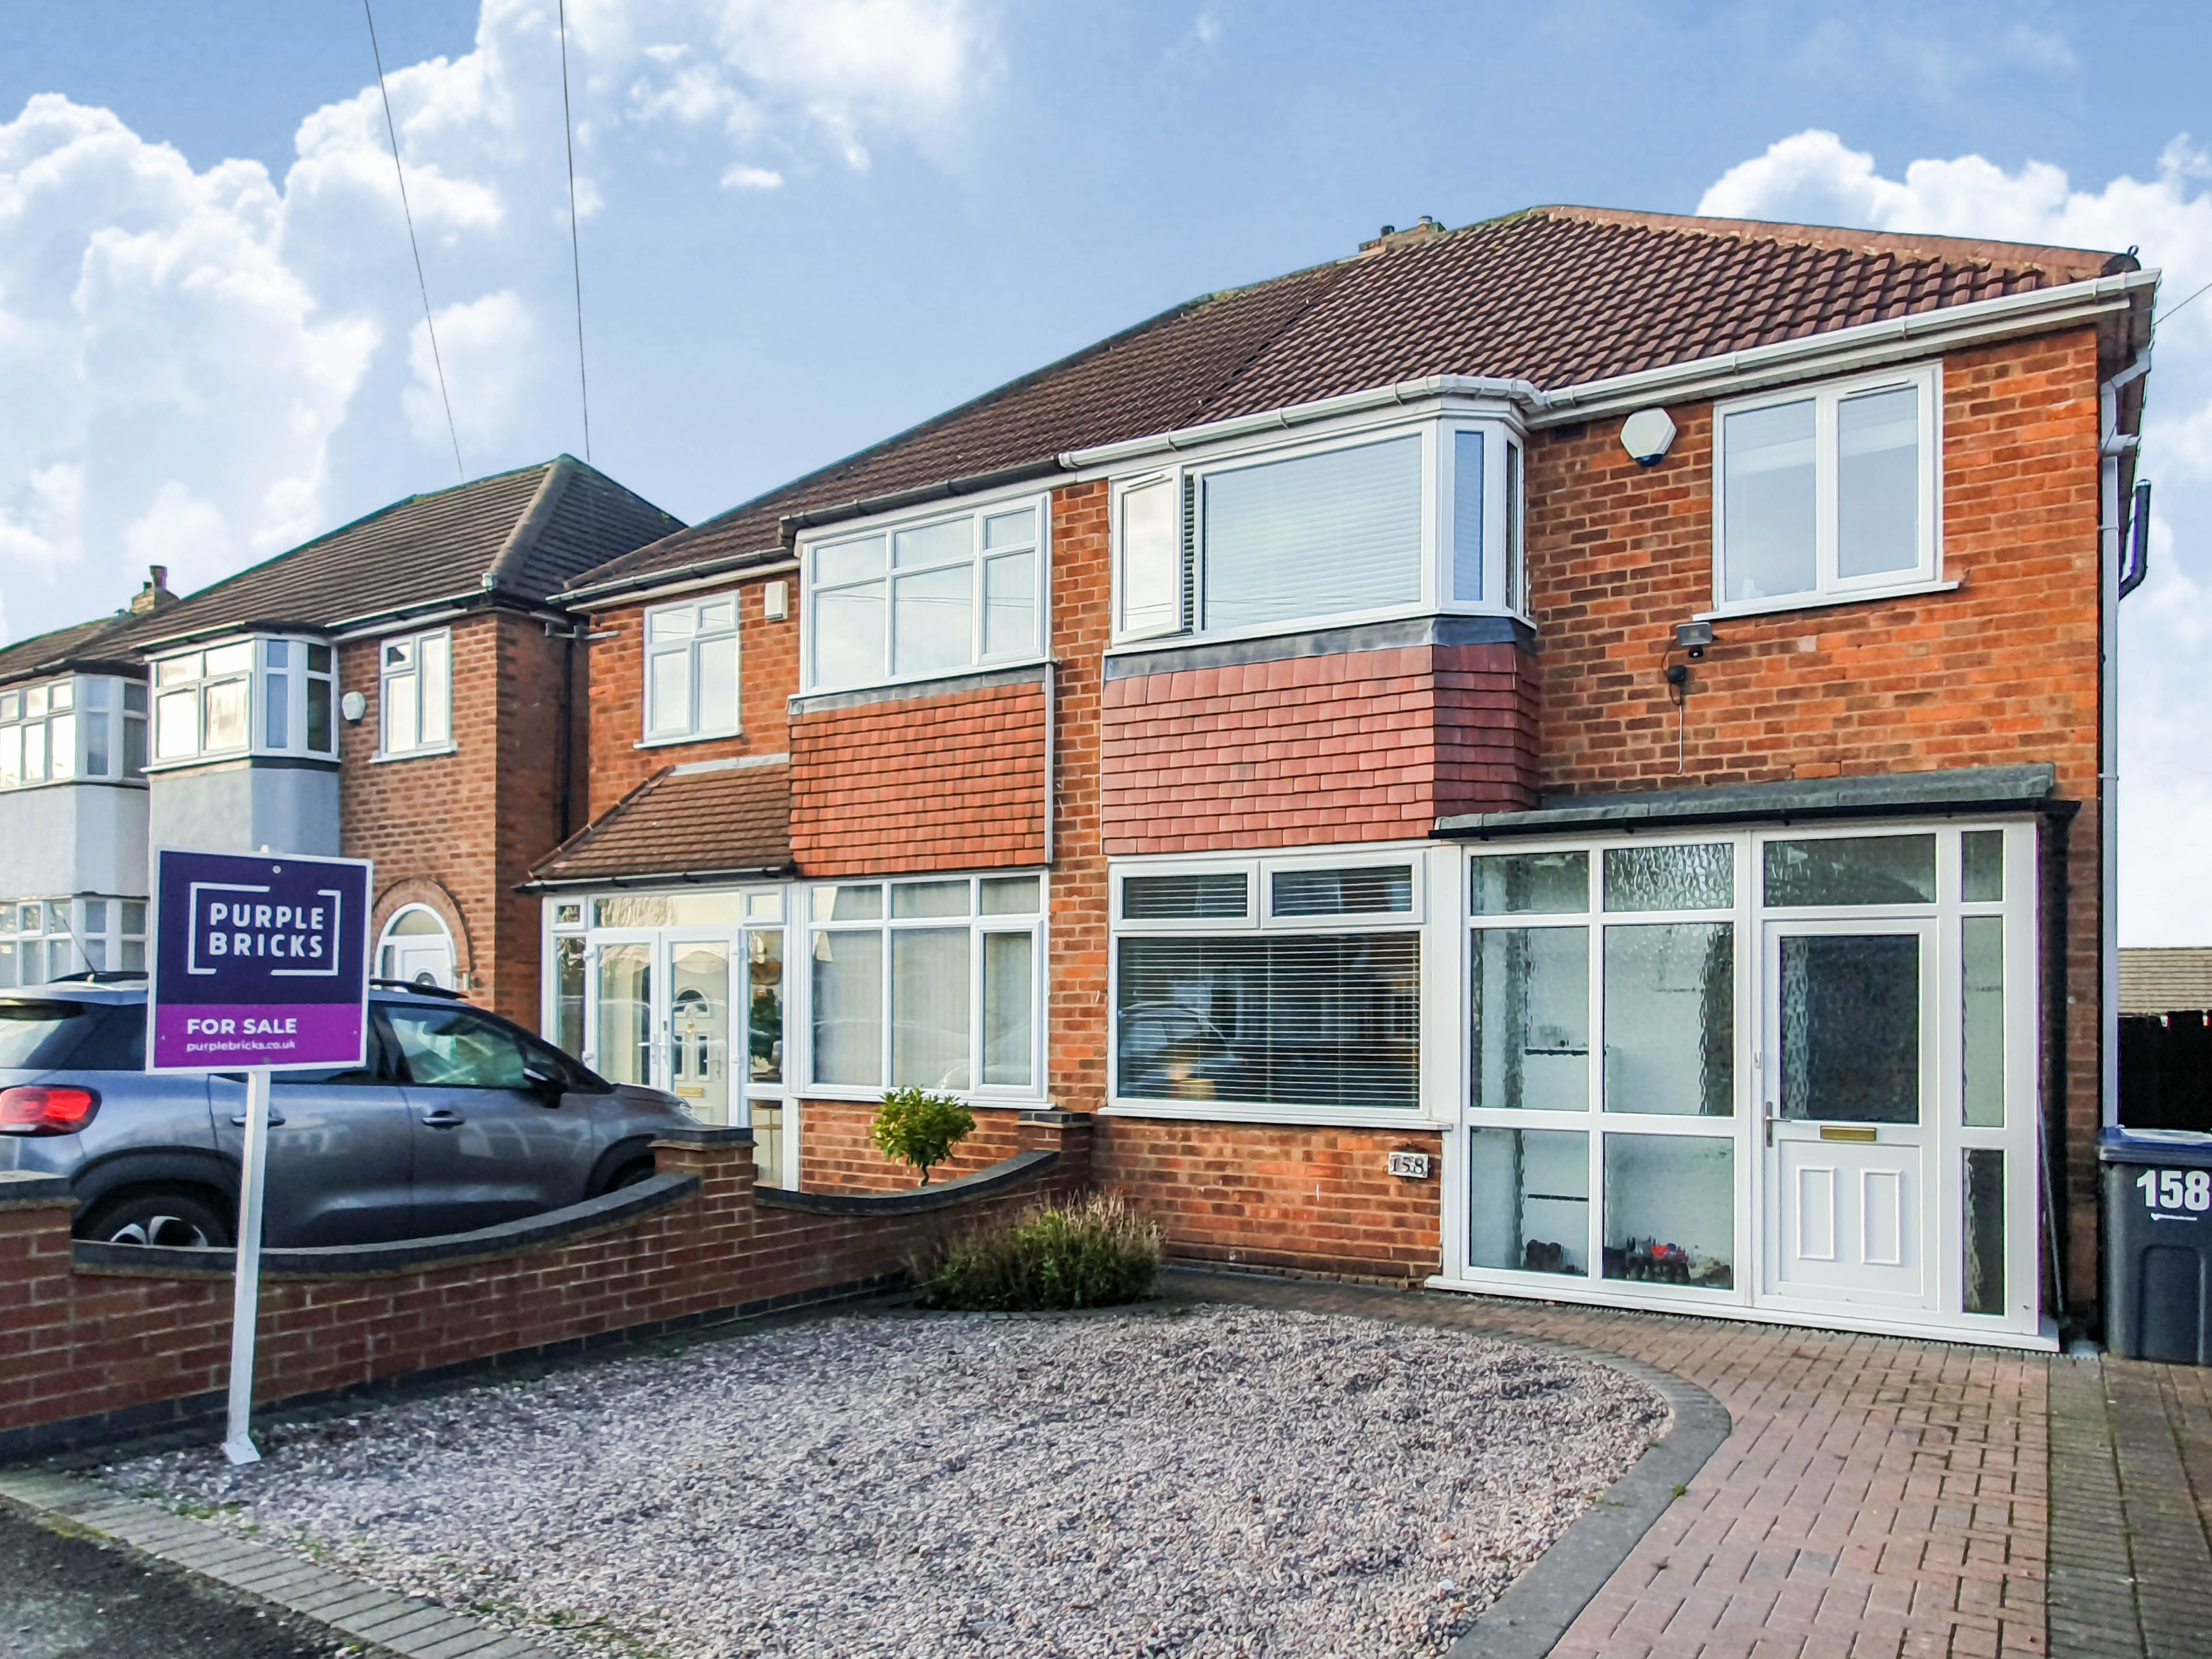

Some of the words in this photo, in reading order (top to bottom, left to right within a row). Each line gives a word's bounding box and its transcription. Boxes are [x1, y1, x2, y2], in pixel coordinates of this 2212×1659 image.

[210, 903, 324, 930] PURPLE
[209, 932, 323, 958] BRICKS
[187, 1019, 235, 1034] FOR
[243, 1018, 297, 1034] SALE
[186, 1039, 296, 1052] purplebricks.co.uk
[2137, 1170, 2210, 1211] 158
